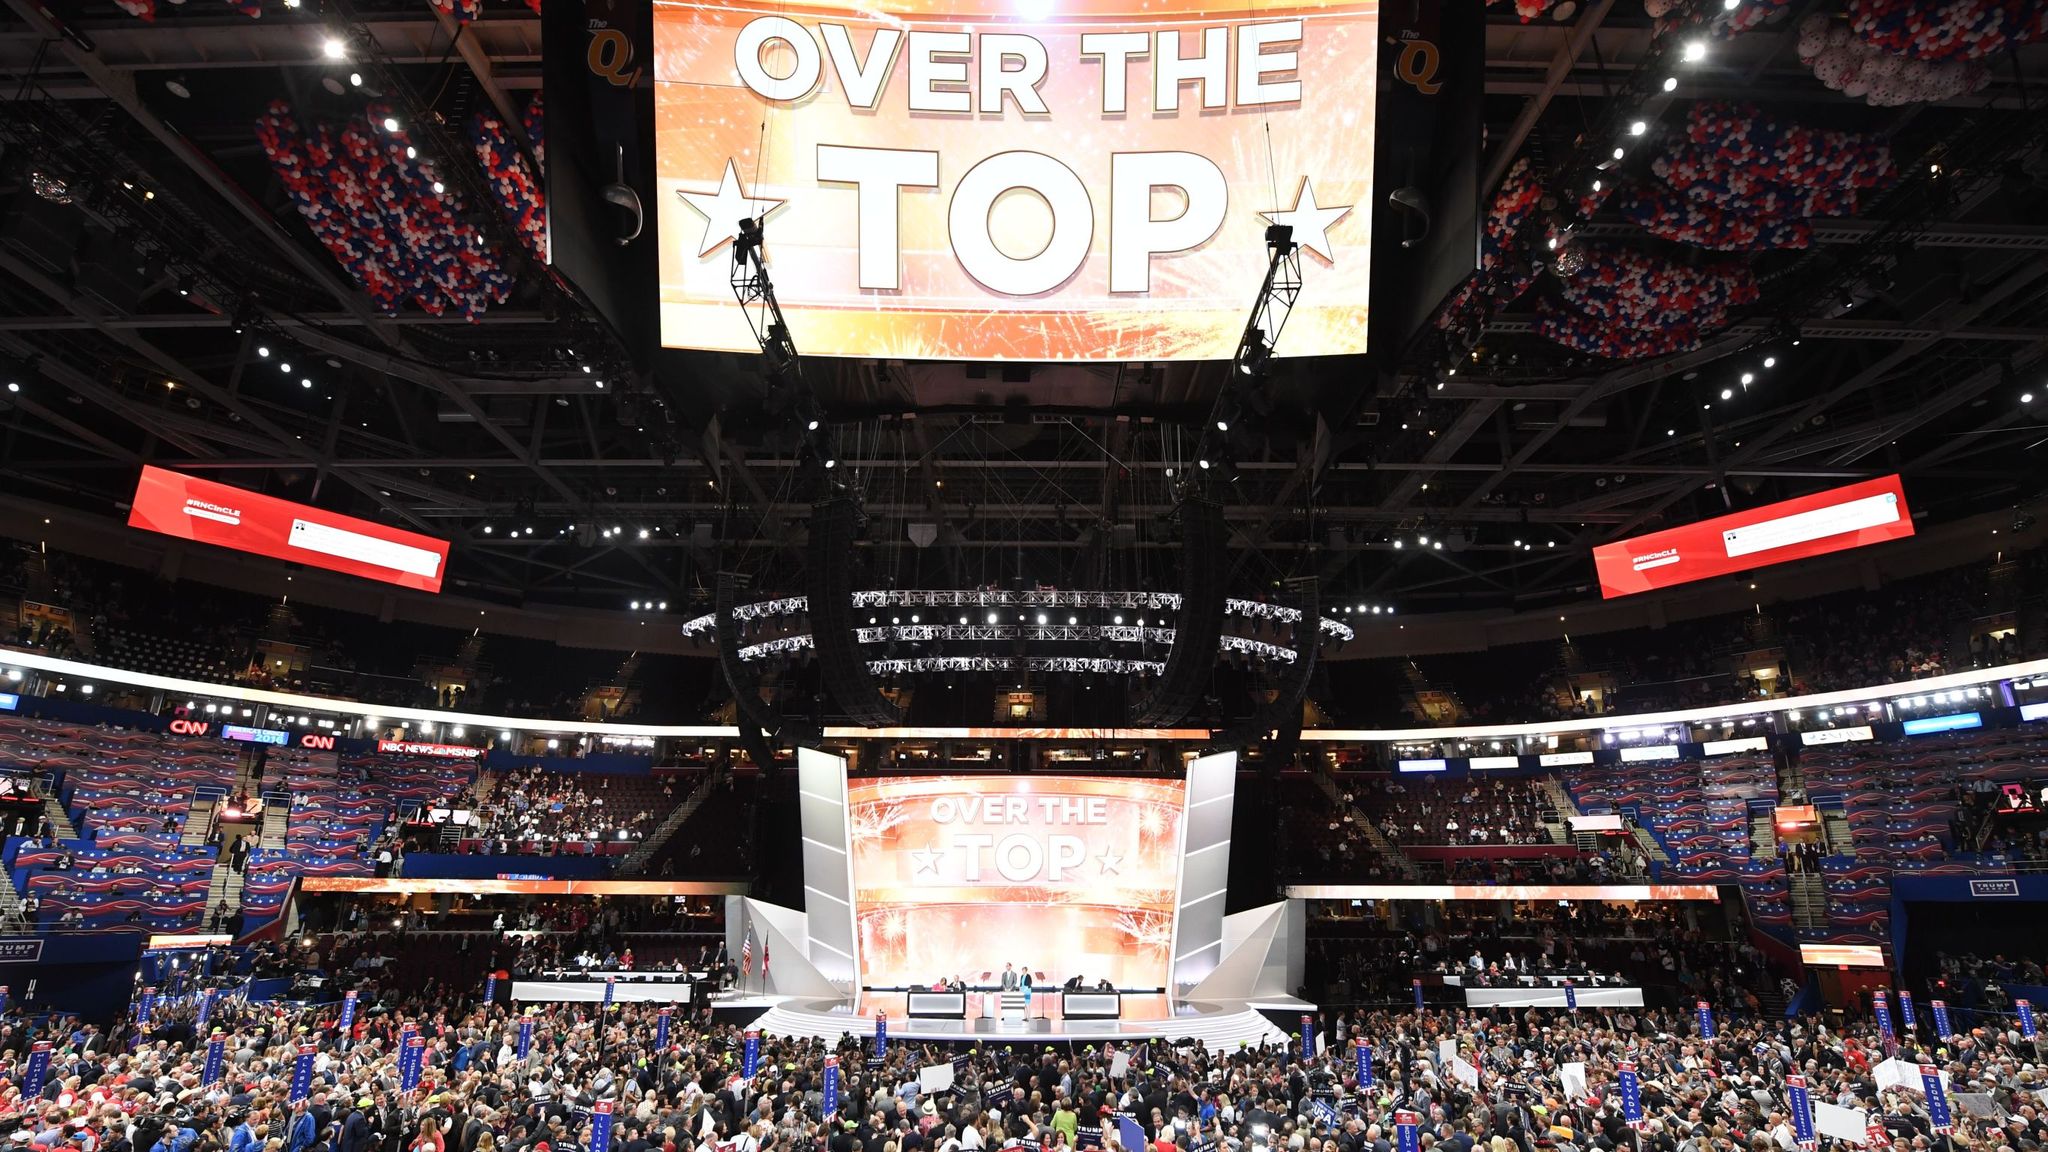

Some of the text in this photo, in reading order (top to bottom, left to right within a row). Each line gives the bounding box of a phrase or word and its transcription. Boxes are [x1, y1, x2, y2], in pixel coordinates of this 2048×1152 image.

[587, 18, 608, 29] The
[1401, 29, 1420, 40] The
[587, 28, 642, 89] Q
[733, 15, 1304, 116] OVER THE
[1394, 40, 1443, 94] Q
[816, 142, 1230, 297] TOP
[169, 719, 209, 735] CNN
[254, 733, 284, 744] 2016
[301, 734, 335, 750] CNN
[381, 742, 405, 752] NBC
[405, 744, 434, 755] NEWS
[931, 796, 1107, 825] OVER THE
[953, 832, 1088, 882] TOP
[29, 1053, 45, 1093] MICHIGAN
[297, 1055, 309, 1095] ALASKA
[1360, 1048, 1369, 1084] WISCONSIN
[987, 1083, 1010, 1095] TRUMP
[1624, 1074, 1636, 1114] NEVADA
[1928, 1077, 1945, 1119] GEORGIA
[1077, 1125, 1103, 1134] TRUMP
[1313, 1105, 1332, 1125] USA
[1017, 1139, 1040, 1147] TRUMP
